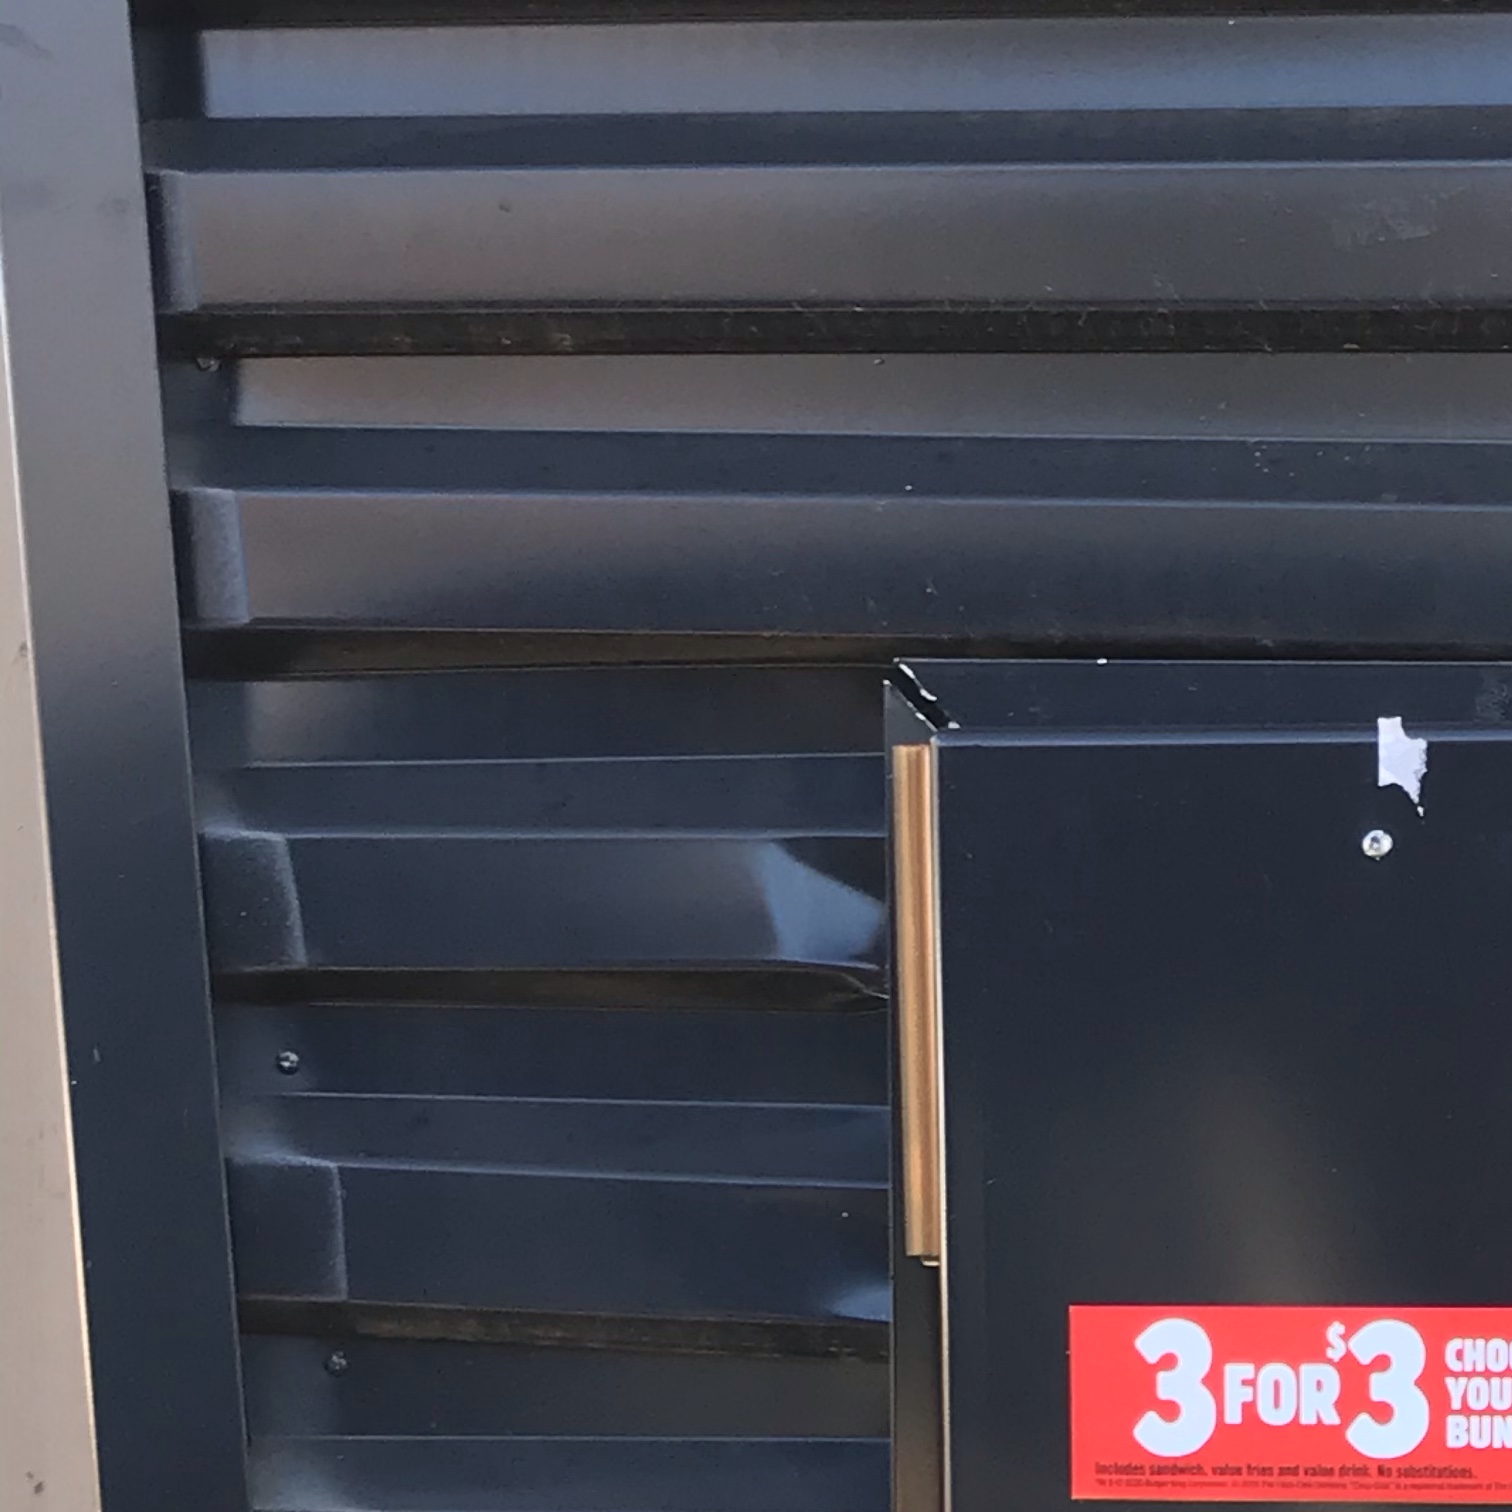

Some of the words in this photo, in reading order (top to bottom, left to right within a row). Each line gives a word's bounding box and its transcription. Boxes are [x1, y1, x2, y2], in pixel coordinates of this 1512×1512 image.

[1132, 1317, 1216, 1457] 3
[1223, 1362, 1341, 1426] FOR
[1095, 1462, 1146, 1475] Includes
[1212, 1464, 1243, 1476] value
[1247, 1464, 1274, 1477] fries
[1277, 1464, 1299, 1477] and
[1304, 1465, 1335, 1477] value
[1377, 1464, 1393, 1478] No
